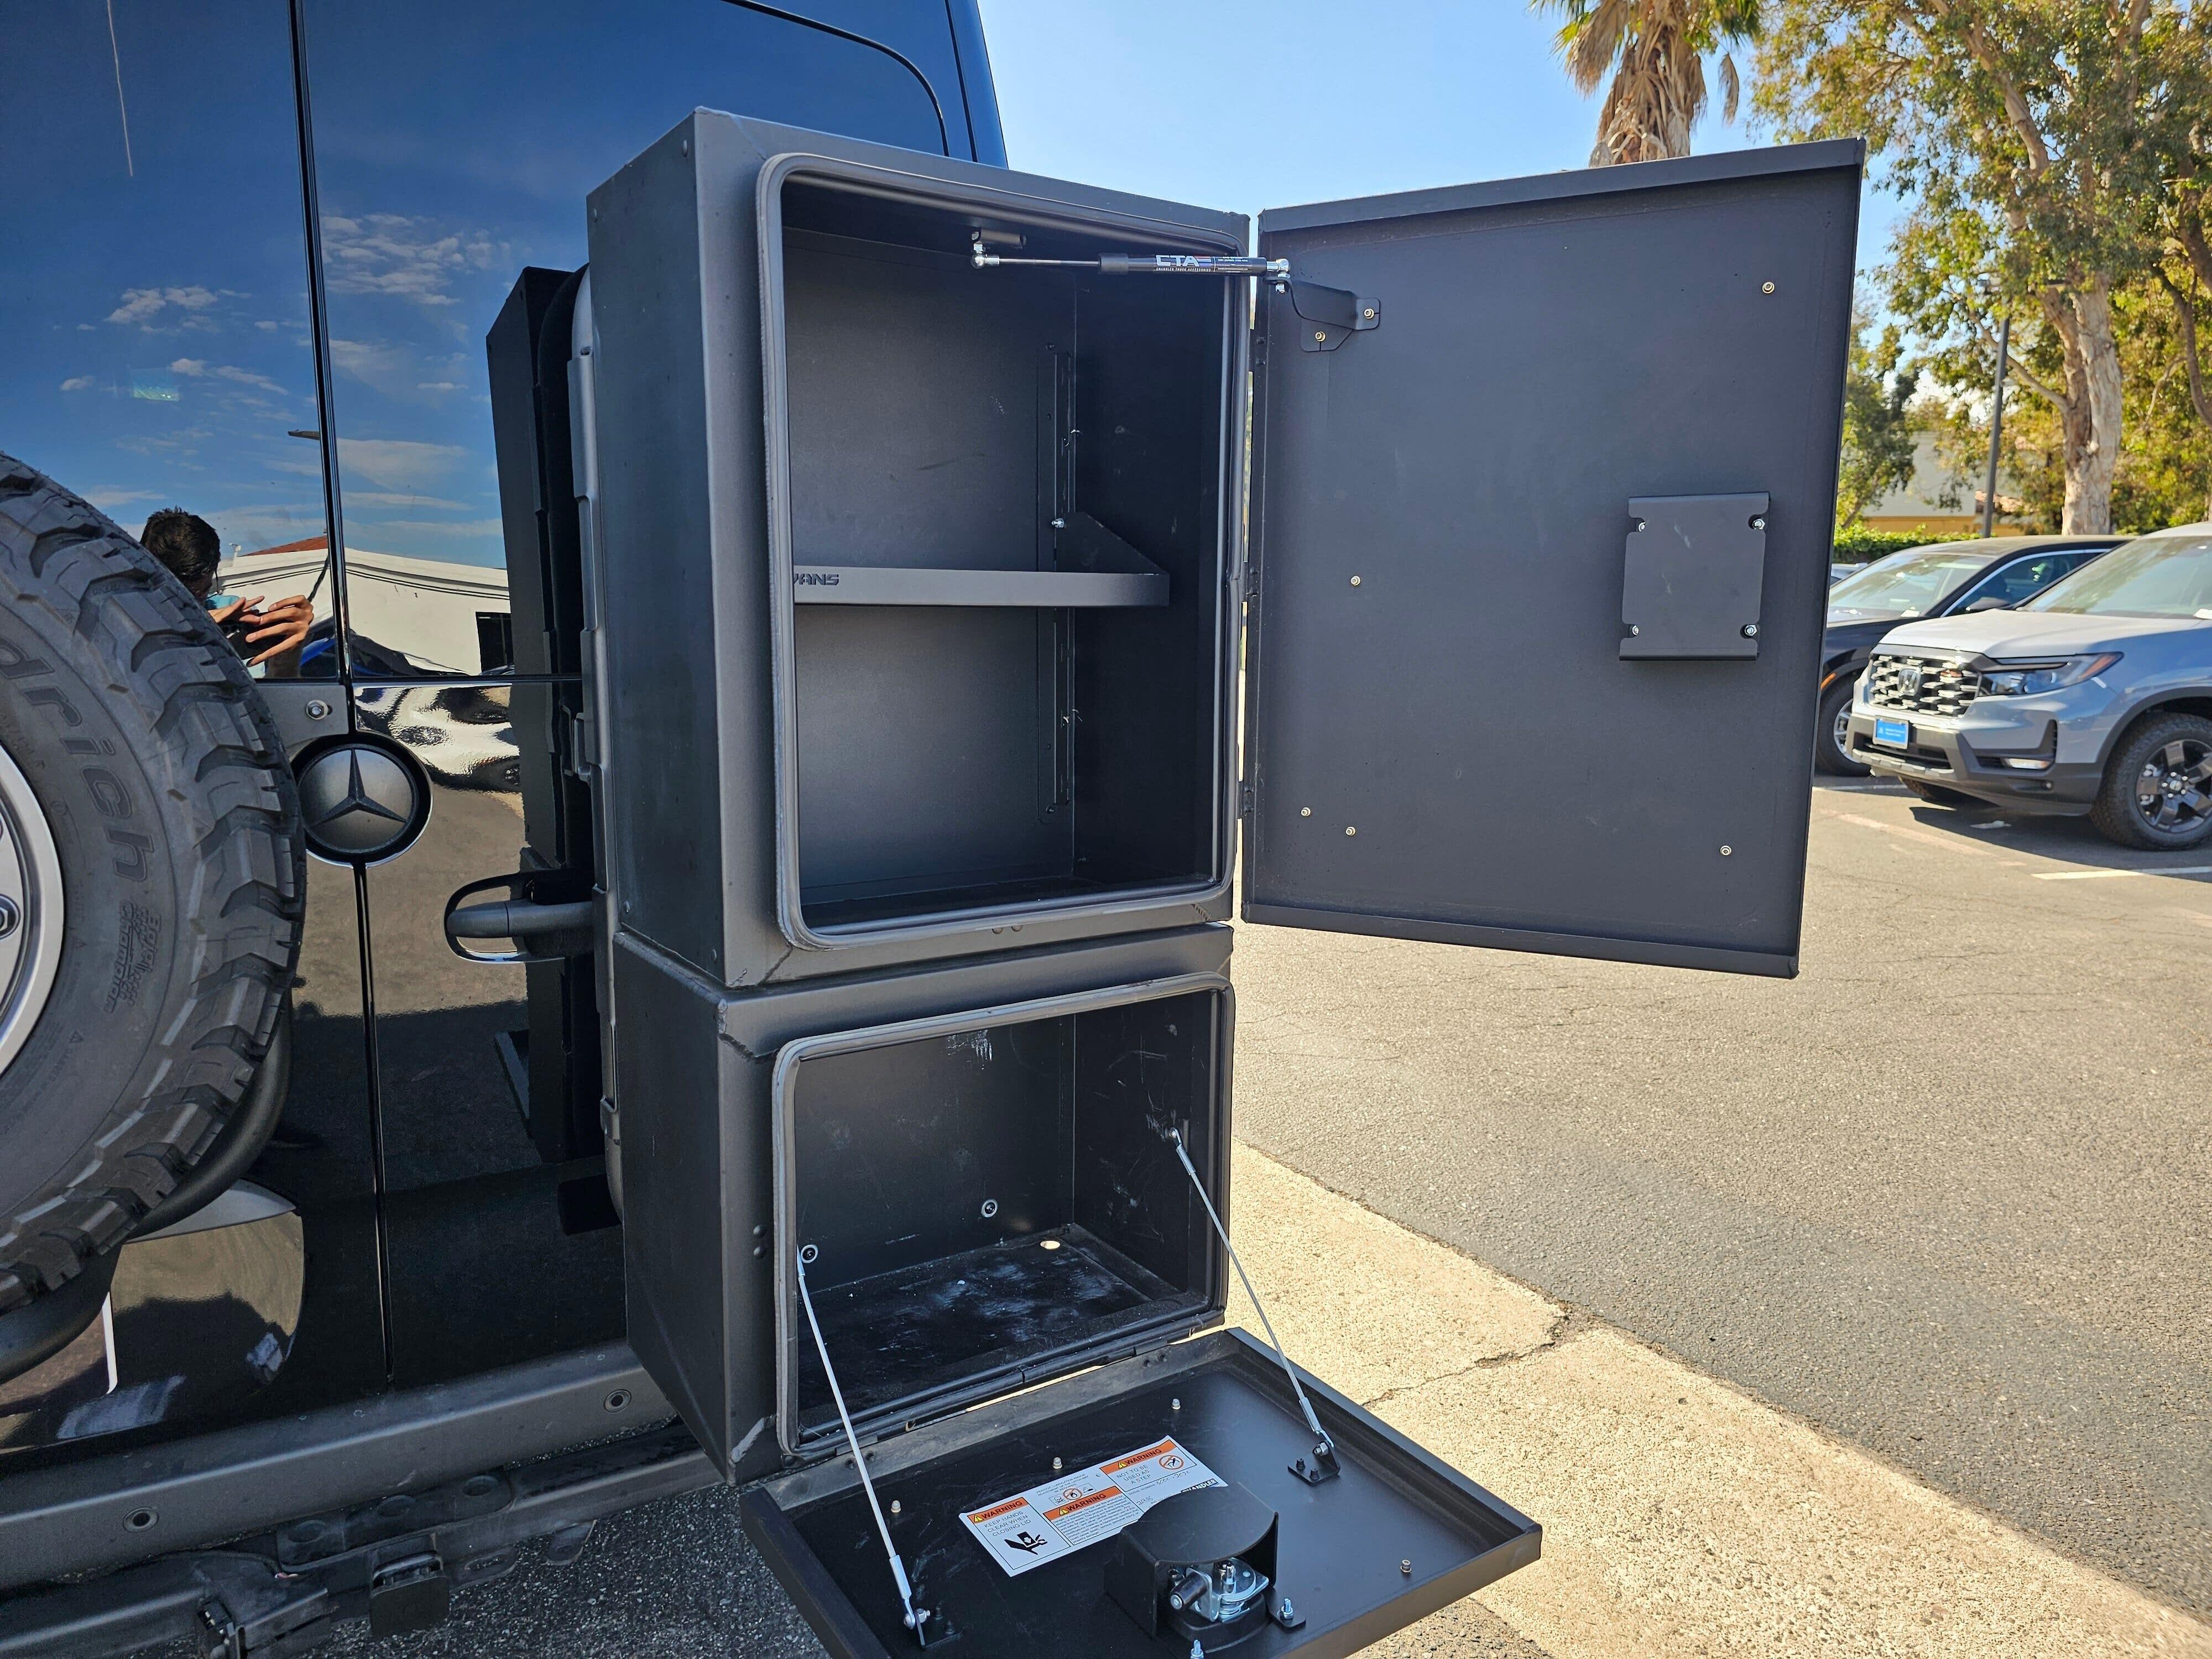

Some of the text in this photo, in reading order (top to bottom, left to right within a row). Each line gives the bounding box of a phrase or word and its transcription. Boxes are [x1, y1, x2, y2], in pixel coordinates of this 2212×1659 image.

[1156, 255, 1199, 267] CTA
[1125, 1448, 1162, 1464] WARNING
[982, 1501, 1022, 1519] WARNING
[1066, 1493, 1106, 1511] WARNING
[984, 1511, 1023, 1527] KEEP HANDS
[987, 1515, 1027, 1532] CLEAR WHEN
[992, 1524, 1020, 1536] CLOSING
